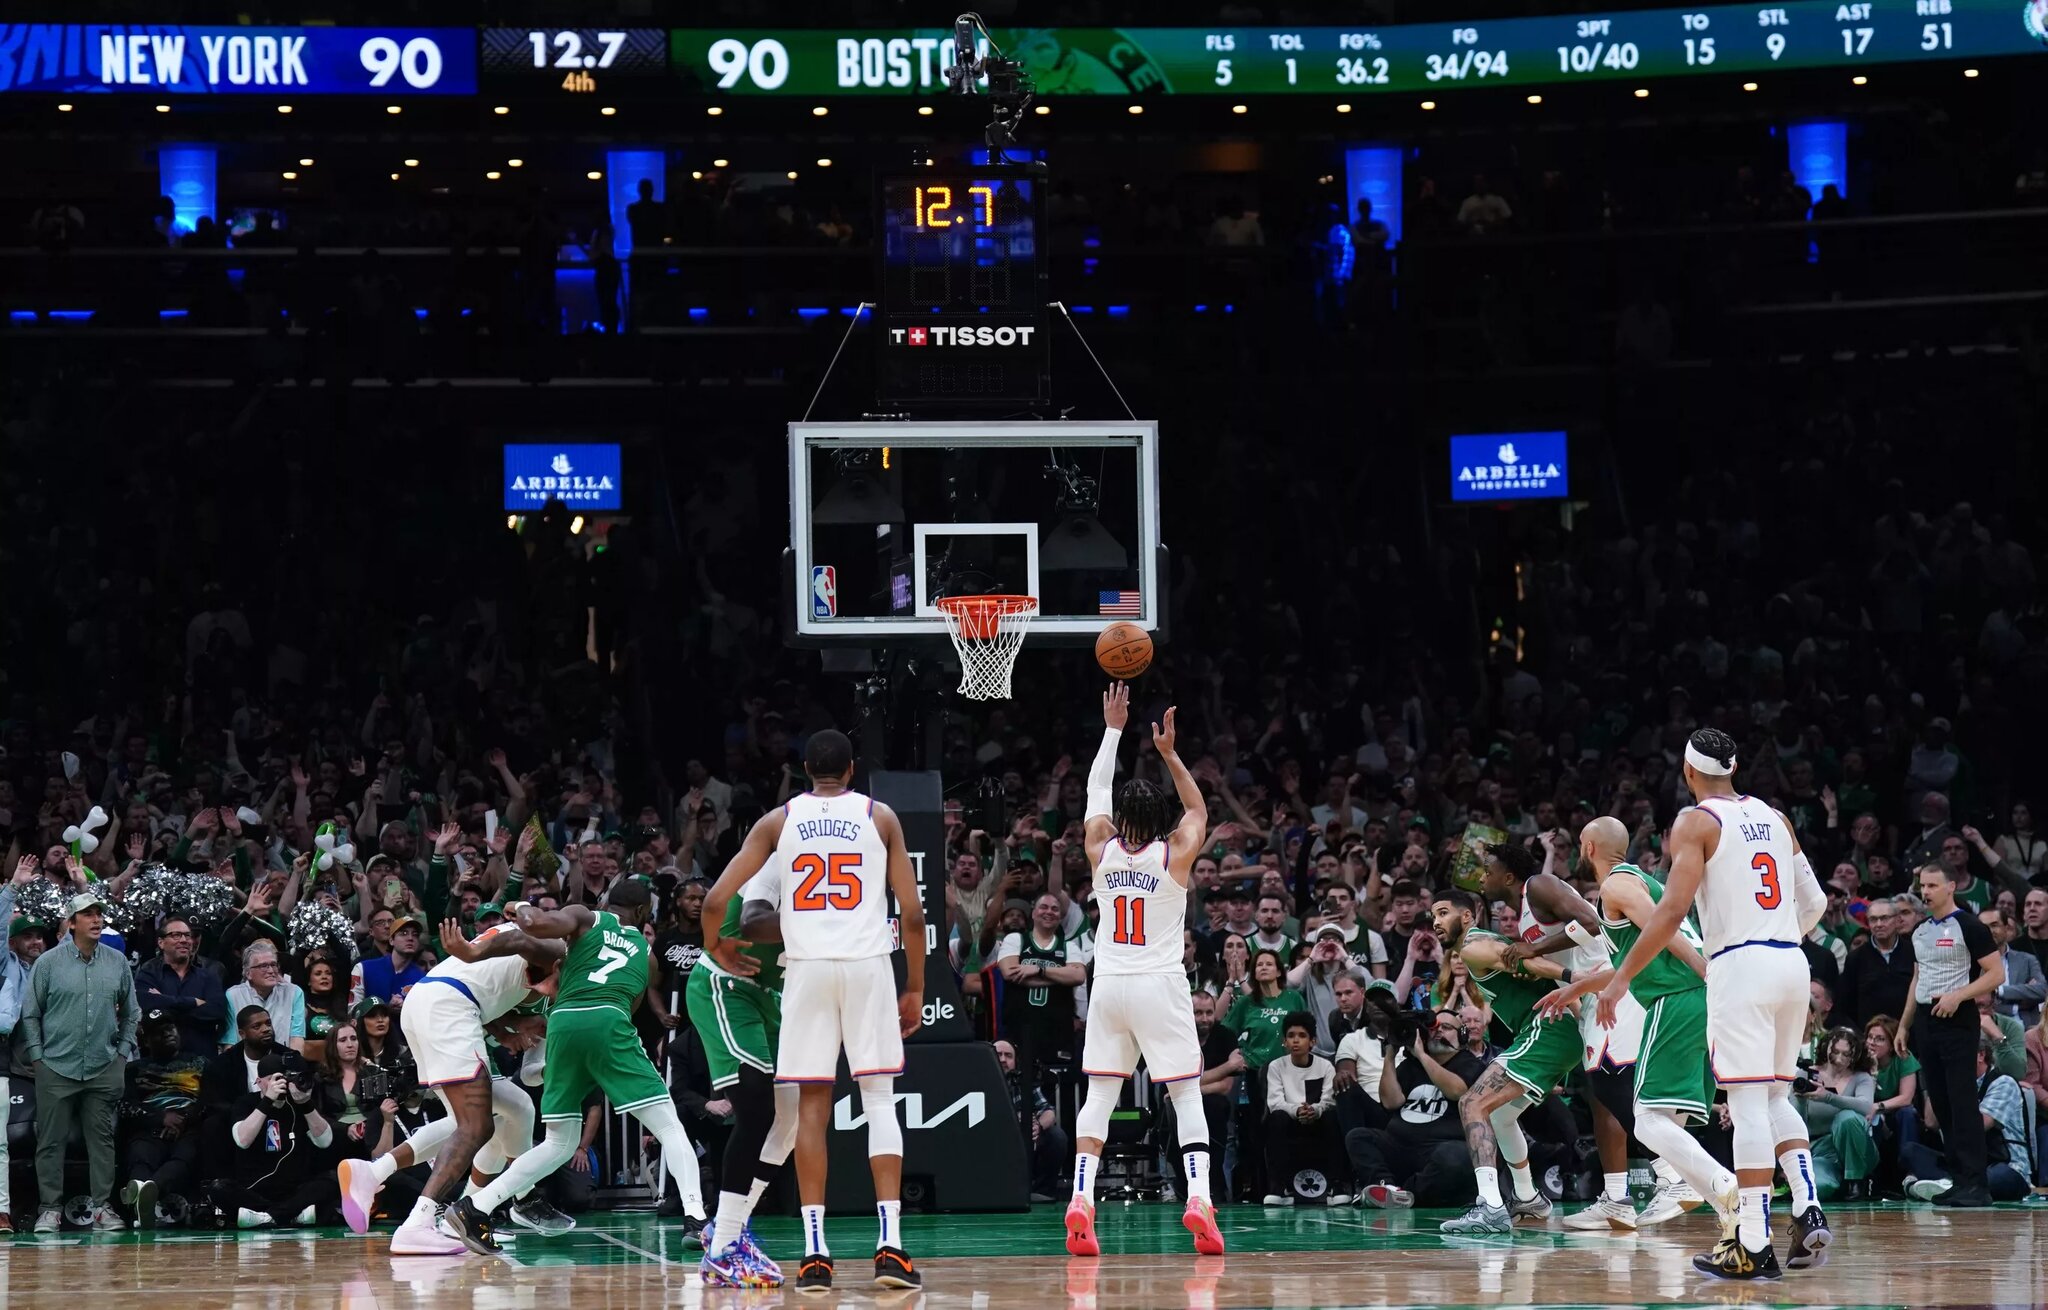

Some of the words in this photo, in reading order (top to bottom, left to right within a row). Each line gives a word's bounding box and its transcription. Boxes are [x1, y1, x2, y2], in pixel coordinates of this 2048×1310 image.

[1206, 35, 1234, 50] FLS
[1269, 34, 1304, 50] TOL
[1340, 34, 1381, 50] FG%
[1453, 28, 1478, 44] FG
[1577, 20, 1611, 37] 3PT
[1683, 14, 1709, 30] TO
[1758, 9, 1789, 26] STL
[1836, 3, 1872, 21] AST
[1916, 0, 1952, 16] REB
[101, 35, 185, 84] NEW
[200, 36, 309, 85] YORK
[360, 37, 442, 88] 90
[528, 31, 627, 68] 12.7
[708, 39, 789, 89] 90
[1215, 60, 1233, 86] 5
[1285, 58, 1297, 84] 1
[1336, 58, 1389, 84] 36.2
[1426, 50, 1509, 81] 34/94
[1557, 42, 1639, 72] 10/40
[1683, 38, 1716, 66] 15
[1766, 33, 1786, 60] 9
[1841, 28, 1874, 55] 17
[1921, 23, 1953, 51] 51
[562, 71, 595, 92] 4th
[915, 186, 993, 227] 12.7
[930, 326, 1035, 346] TISSOT
[511, 475, 613, 490] ARBELLA
[1458, 463, 1560, 481] ARBELLA
[524, 491, 600, 500] INSRANCE
[797, 819, 860, 841] BRIDGES
[1740, 823, 1771, 842] HART
[792, 853, 862, 911] 25
[1105, 870, 1159, 893] BRUNSON
[1751, 852, 1782, 910] 3
[1113, 895, 1146, 946] 11
[602, 930, 640, 957] BROWN
[587, 945, 629, 984] 7
[921, 997, 955, 1026] gle
